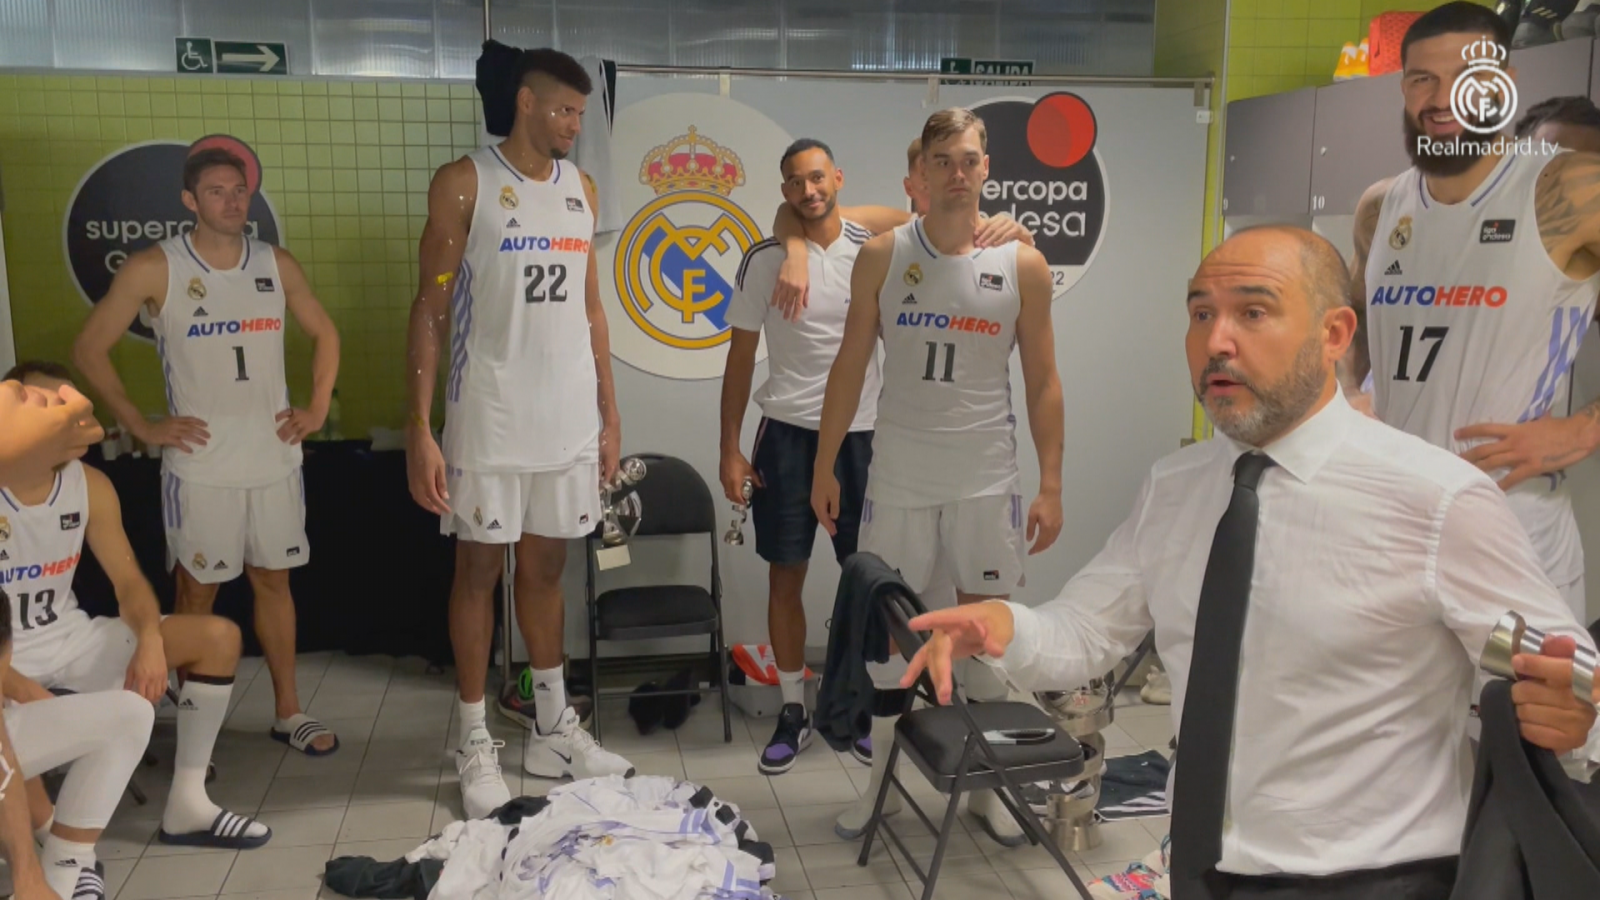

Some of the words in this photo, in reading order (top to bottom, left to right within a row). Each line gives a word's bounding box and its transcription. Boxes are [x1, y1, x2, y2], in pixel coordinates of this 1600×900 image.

[982, 180, 1088, 205] ercopa
[1312, 195, 1325, 211] 10
[86, 220, 259, 244] superca
[499, 236, 589, 253] AUTOHERO
[524, 264, 567, 303] 22
[1370, 285, 1508, 308] AUTOHERO
[187, 318, 281, 338] AUTOHERO
[896, 312, 1001, 336] AUTOHERO
[232, 346, 249, 381] 1
[922, 341, 956, 382] 11
[1392, 325, 1449, 382] 17
[17, 588, 58, 631] 13
